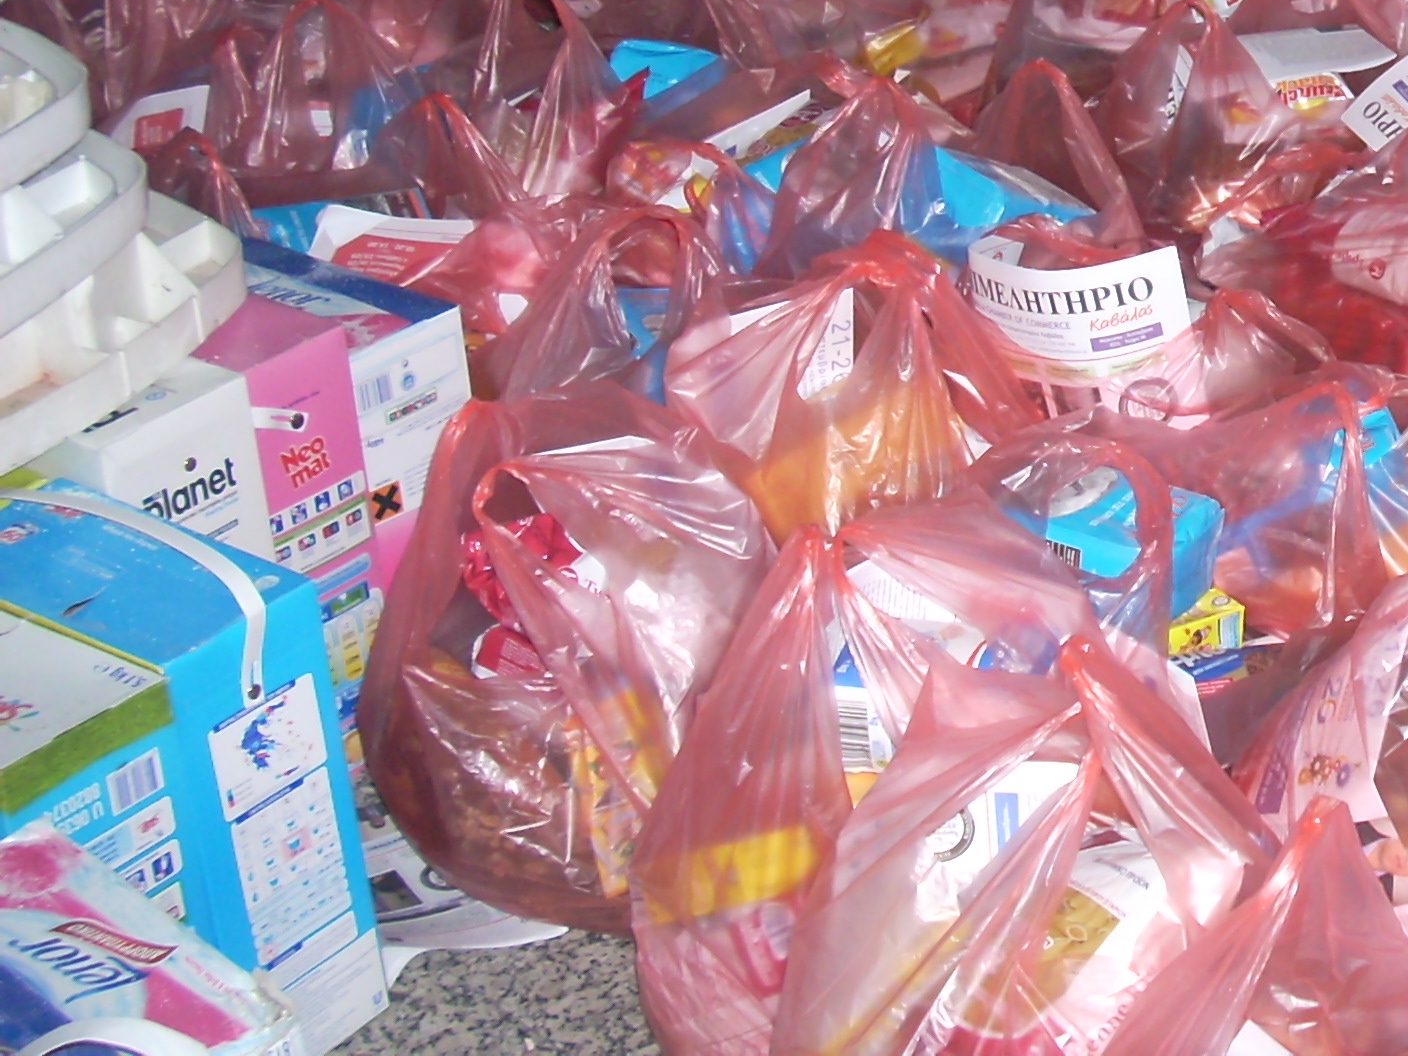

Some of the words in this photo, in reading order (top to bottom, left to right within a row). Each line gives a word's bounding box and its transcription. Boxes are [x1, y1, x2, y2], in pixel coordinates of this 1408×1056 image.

[279, 435, 325, 474] Neo
[290, 451, 332, 489] mat
[9, 937, 153, 1005] Lenor
